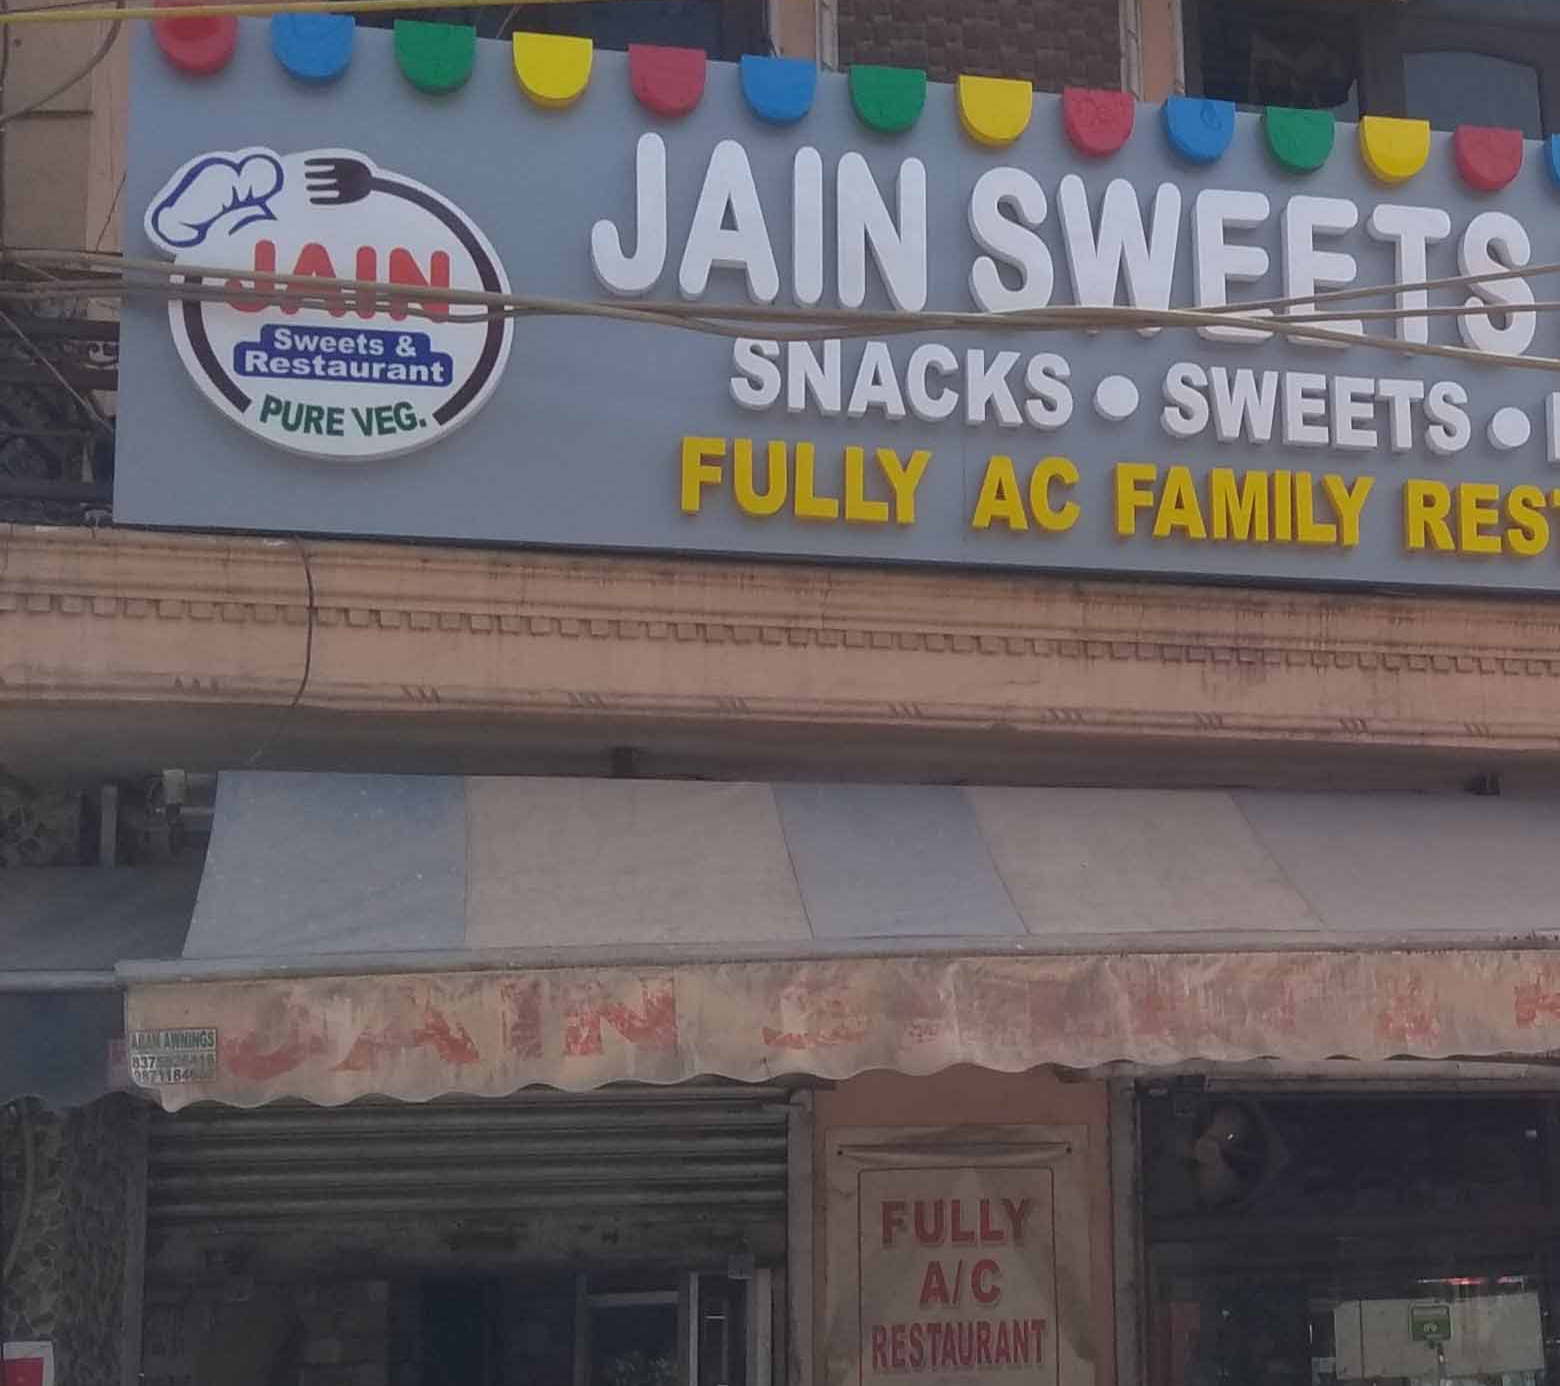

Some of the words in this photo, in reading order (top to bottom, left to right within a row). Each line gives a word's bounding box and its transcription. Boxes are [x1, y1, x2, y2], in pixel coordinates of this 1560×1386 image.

[591, 131, 928, 313] JAIN
[969, 166, 1537, 356] SWEETS
[224, 239, 450, 322] JAIN
[243, 350, 445, 384] Restaurant
[273, 327, 385, 356] Sweets
[395, 333, 417, 357] &
[259, 393, 346, 437] PURE
[352, 401, 428, 436] VEG.
[729, 337, 1073, 431] SNACKS
[1160, 360, 1471, 455] SWEETS
[680, 435, 932, 524] FULLY
[972, 453, 1081, 533] AC
[1112, 461, 1375, 548] FAMILY
[880, 1198, 1033, 1247] FULLY
[919, 1257, 1002, 1308] A/C
[871, 1318, 1047, 1373] RESTAURANT
